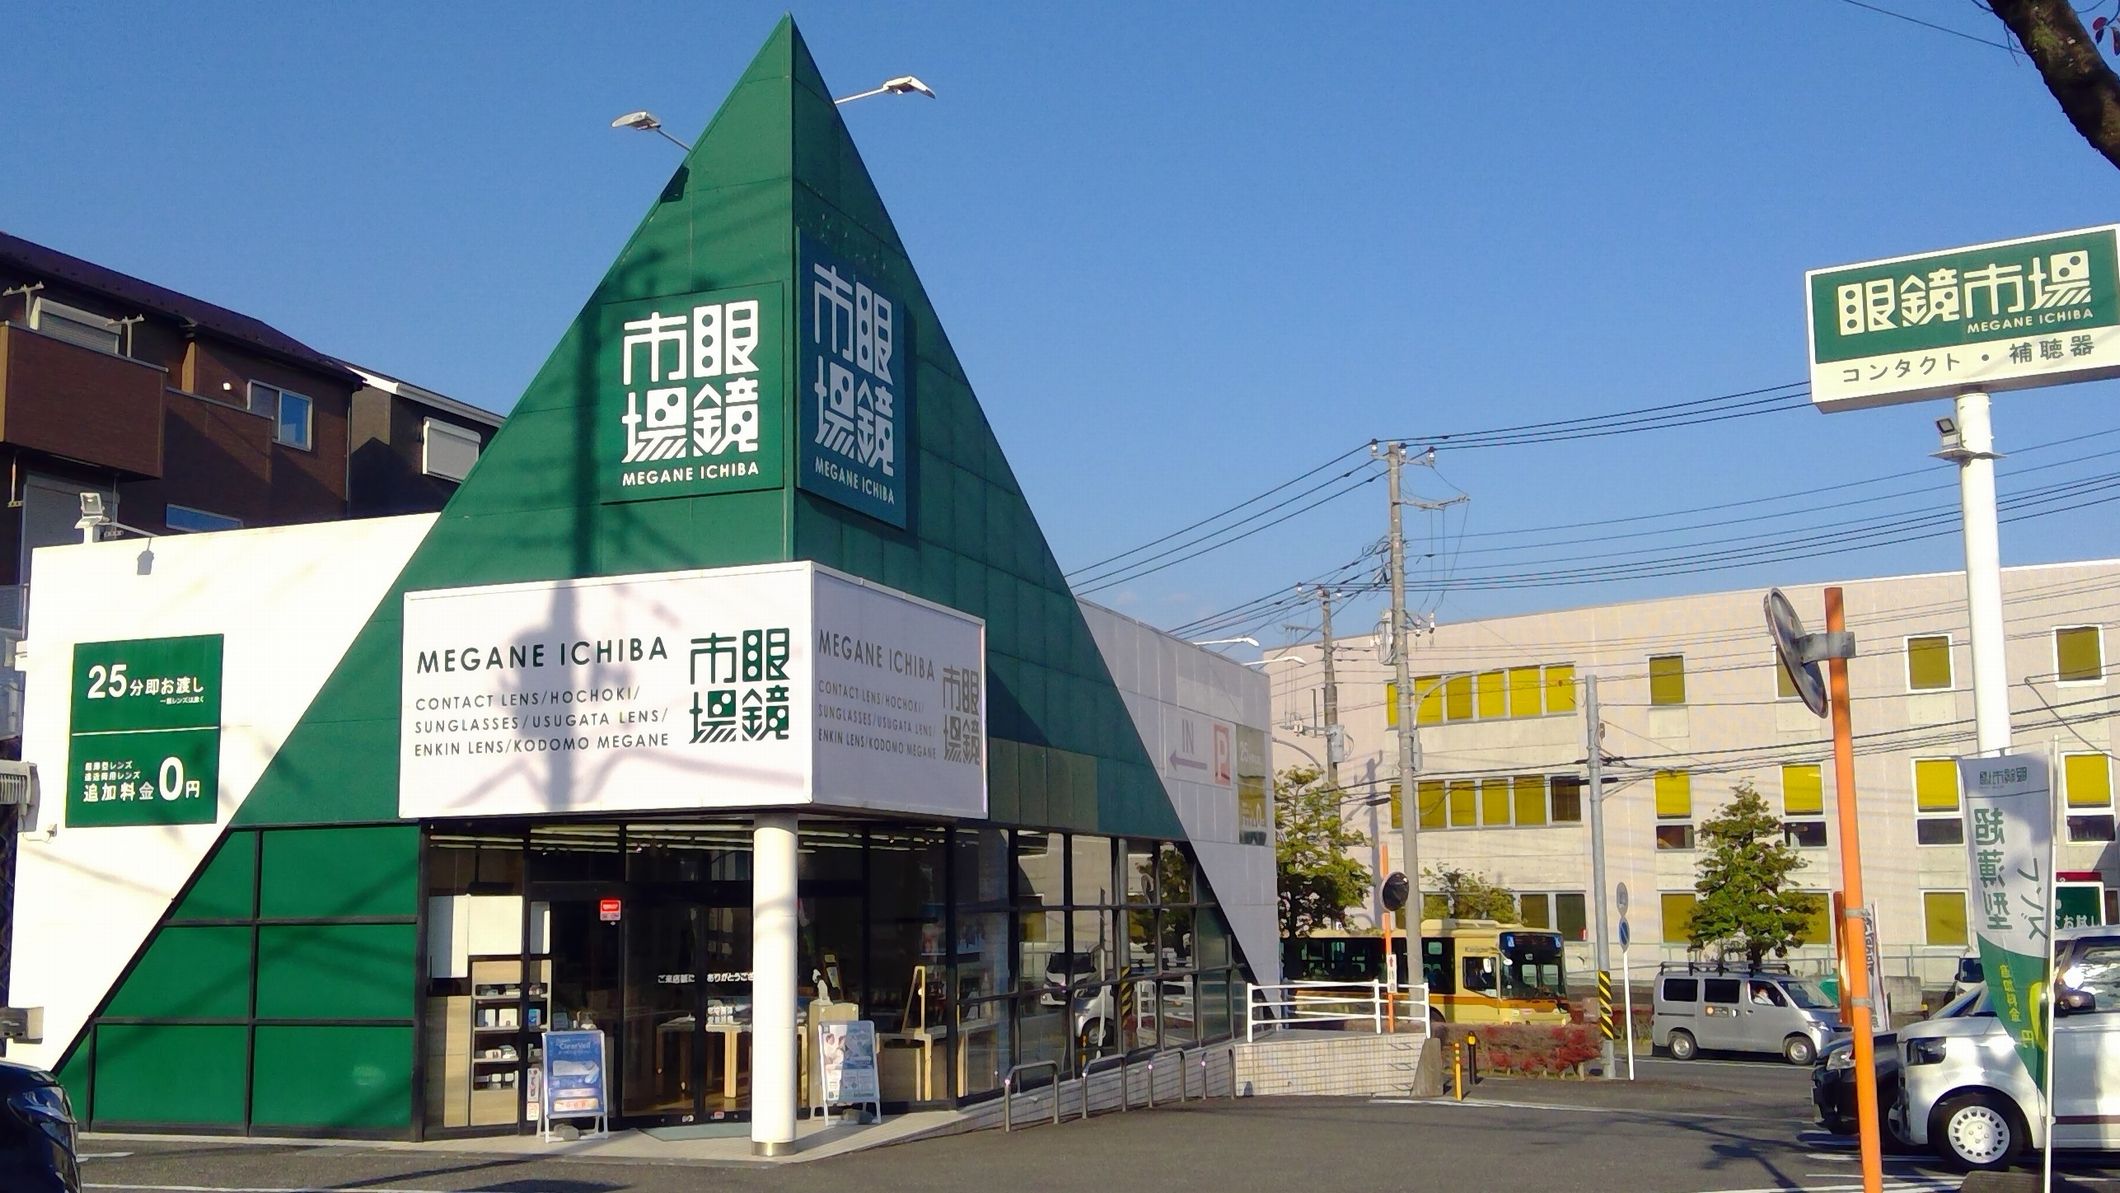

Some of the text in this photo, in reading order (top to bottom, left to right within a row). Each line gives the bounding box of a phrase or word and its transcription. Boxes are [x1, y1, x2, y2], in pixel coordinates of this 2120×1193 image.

[1838, 250, 2092, 336] 眼鏡市場
[1967, 307, 2094, 334] MEGANE ICHIBA
[622, 461, 760, 487] MEGANE ICHIBA
[815, 456, 895, 505] MEGANE ICHIBA
[417, 635, 668, 674] MEGANE ICHIBA
[819, 629, 936, 682] MEGANE ICHIBA
[87, 663, 205, 699] 25分即お渡し
[818, 679, 859, 700] CONTACT
[415, 695, 494, 711] CONTACT
[618, 707, 668, 724] LENS/
[415, 742, 461, 757] ENKIN
[596, 732, 669, 749] MEGANE
[818, 728, 844, 745] ENKIN
[906, 743, 937, 760] MEGANE
[1182, 719, 1194, 755] IN
